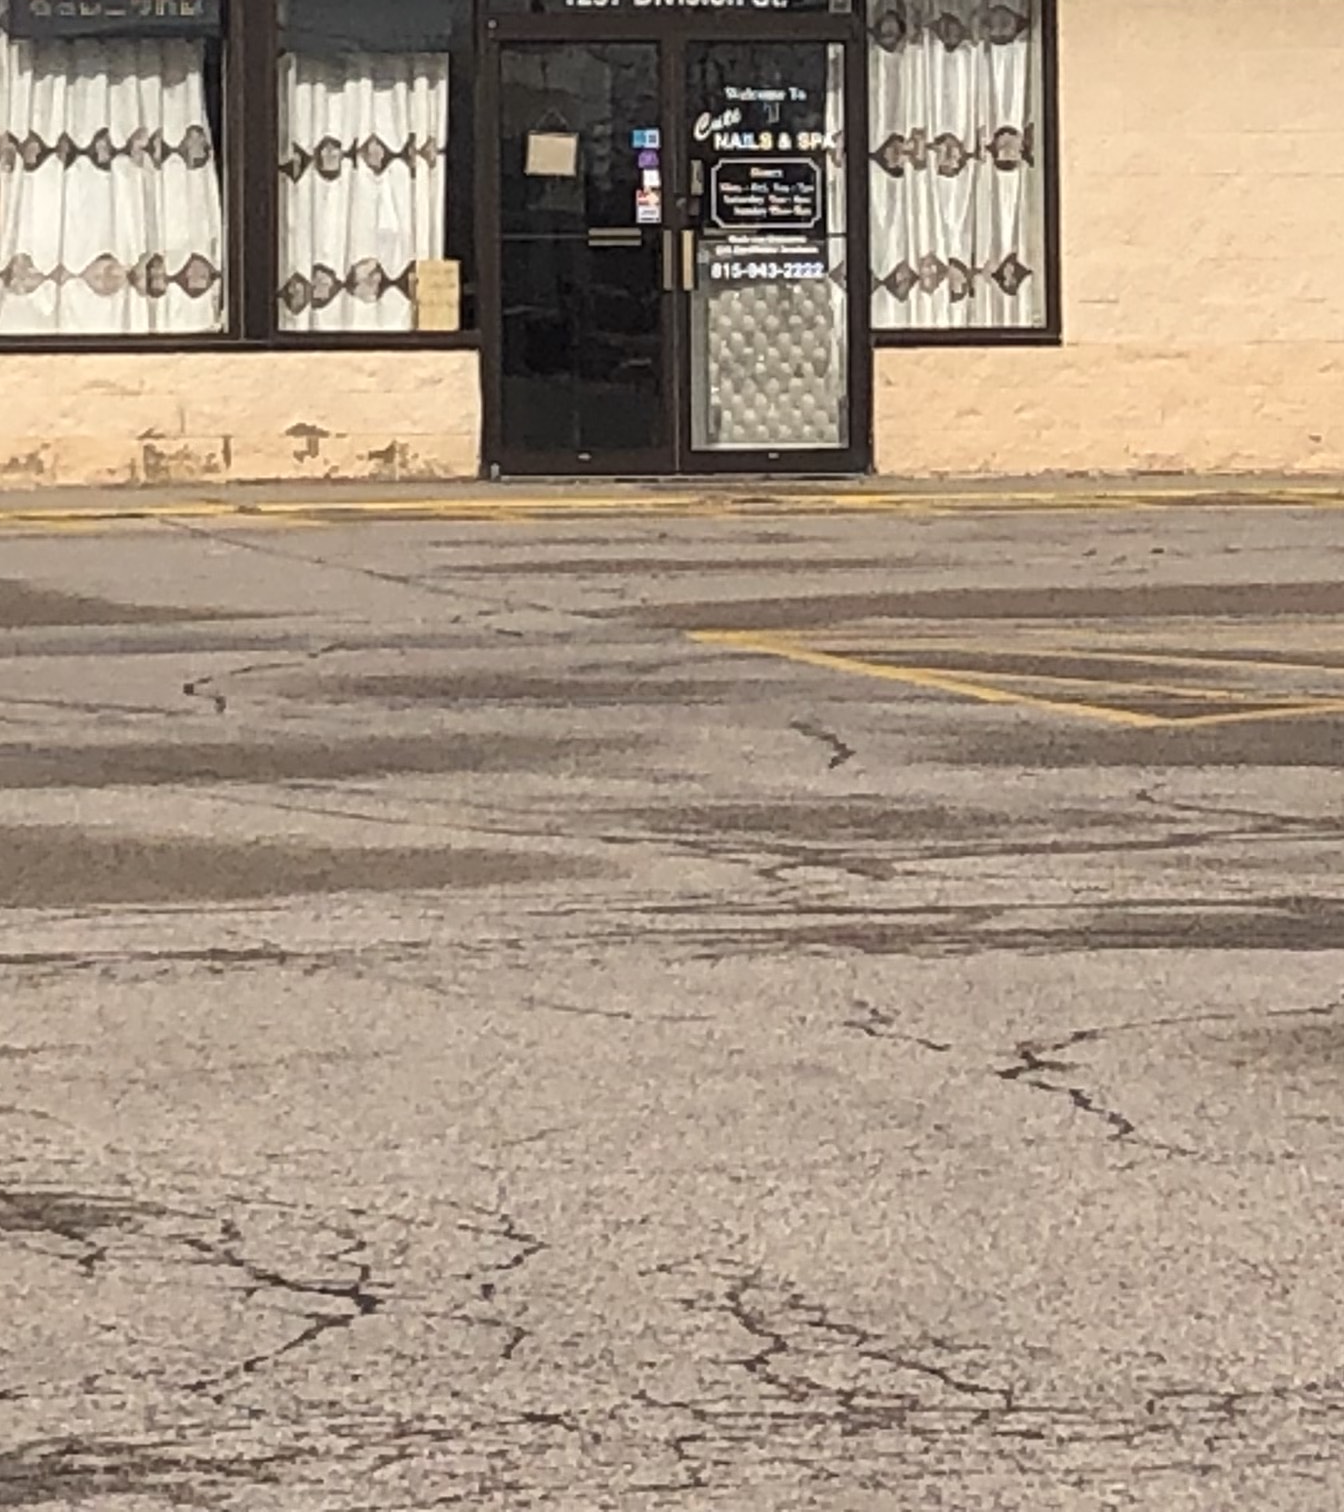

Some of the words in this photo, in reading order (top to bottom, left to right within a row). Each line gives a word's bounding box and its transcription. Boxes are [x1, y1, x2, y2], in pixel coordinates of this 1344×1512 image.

[693, 108, 742, 141] Cute
[713, 131, 773, 150] NAILS
[777, 131, 792, 150] &
[797, 131, 837, 150] SPA
